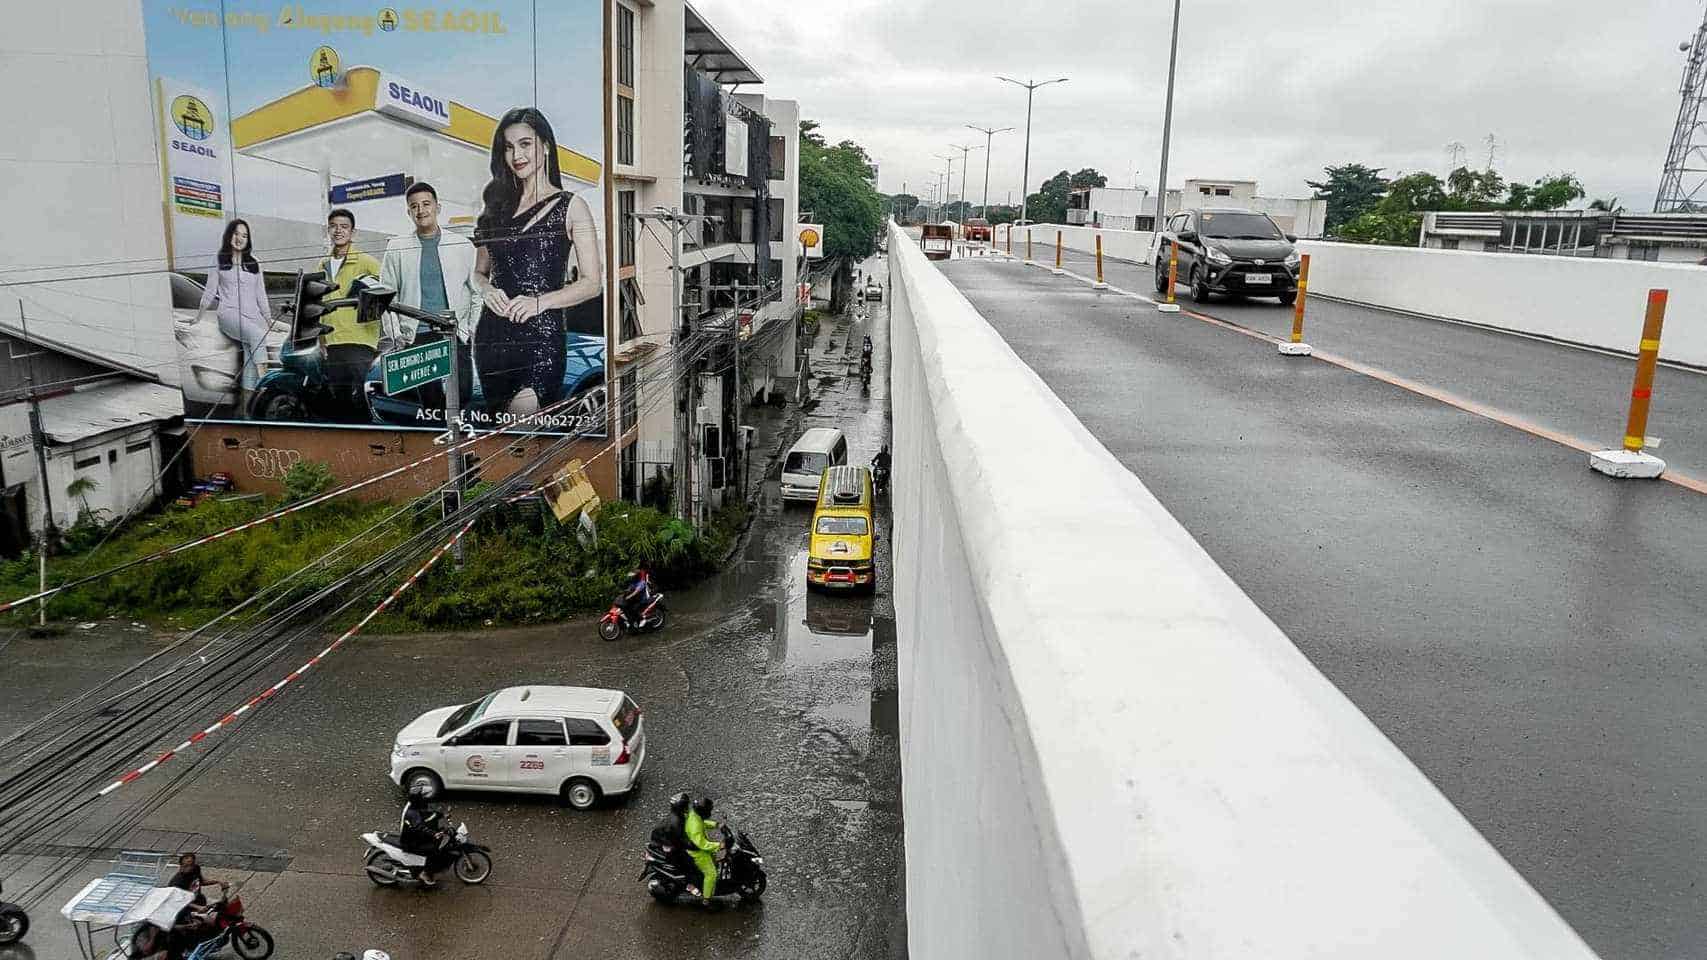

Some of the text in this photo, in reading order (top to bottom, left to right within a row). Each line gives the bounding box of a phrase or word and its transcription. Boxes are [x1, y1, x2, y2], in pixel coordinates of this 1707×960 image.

[403, 9, 508, 33] SEAOIL
[389, 82, 449, 118] SEAOIL
[172, 140, 217, 158] SEAOIL
[410, 364, 431, 381] AVENUE
[416, 408, 441, 421] ASC
[471, 410, 492, 423] No.
